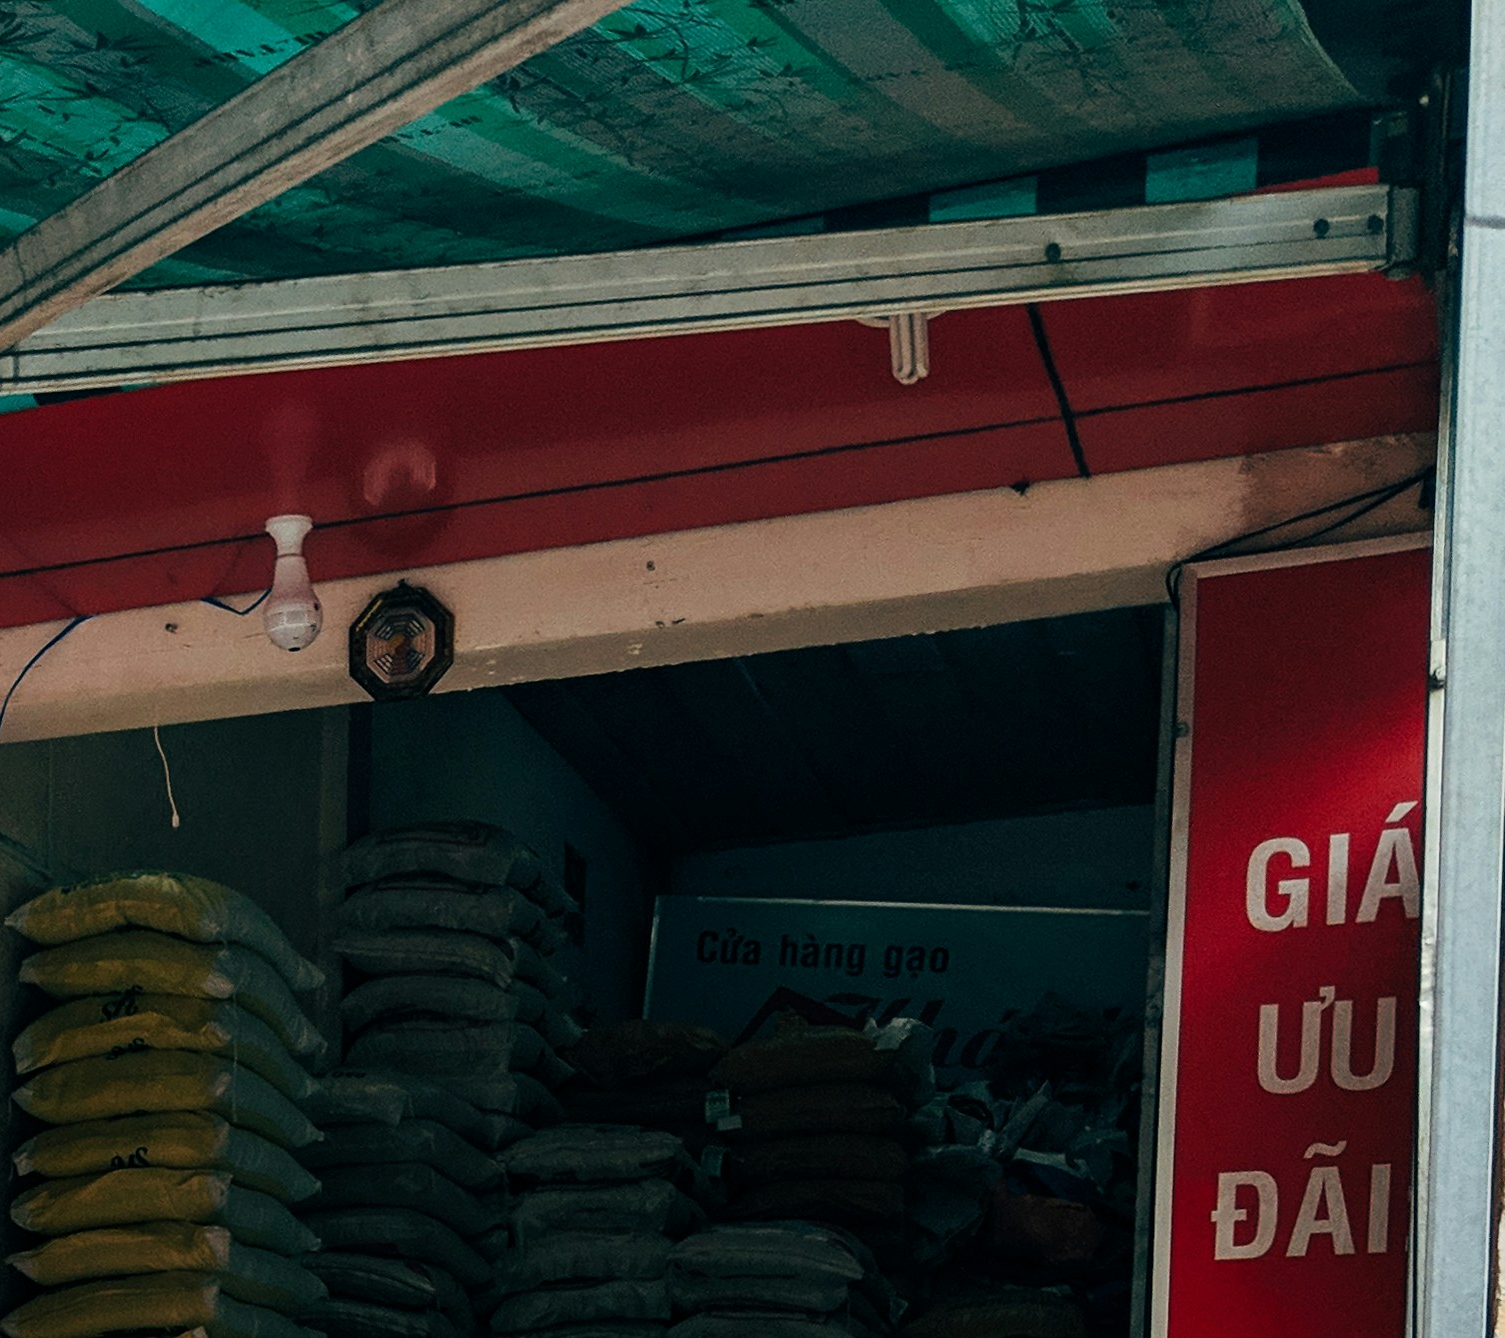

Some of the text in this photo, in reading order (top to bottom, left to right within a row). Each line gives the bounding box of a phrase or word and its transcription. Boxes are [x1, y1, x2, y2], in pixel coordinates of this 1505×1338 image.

[1246, 801, 1420, 933] GIÁ
[697, 928, 949, 978] Cửa hàng gạo
[1258, 985, 1396, 1095] ƯU
[1211, 1140, 1392, 1261] ĐÃI
